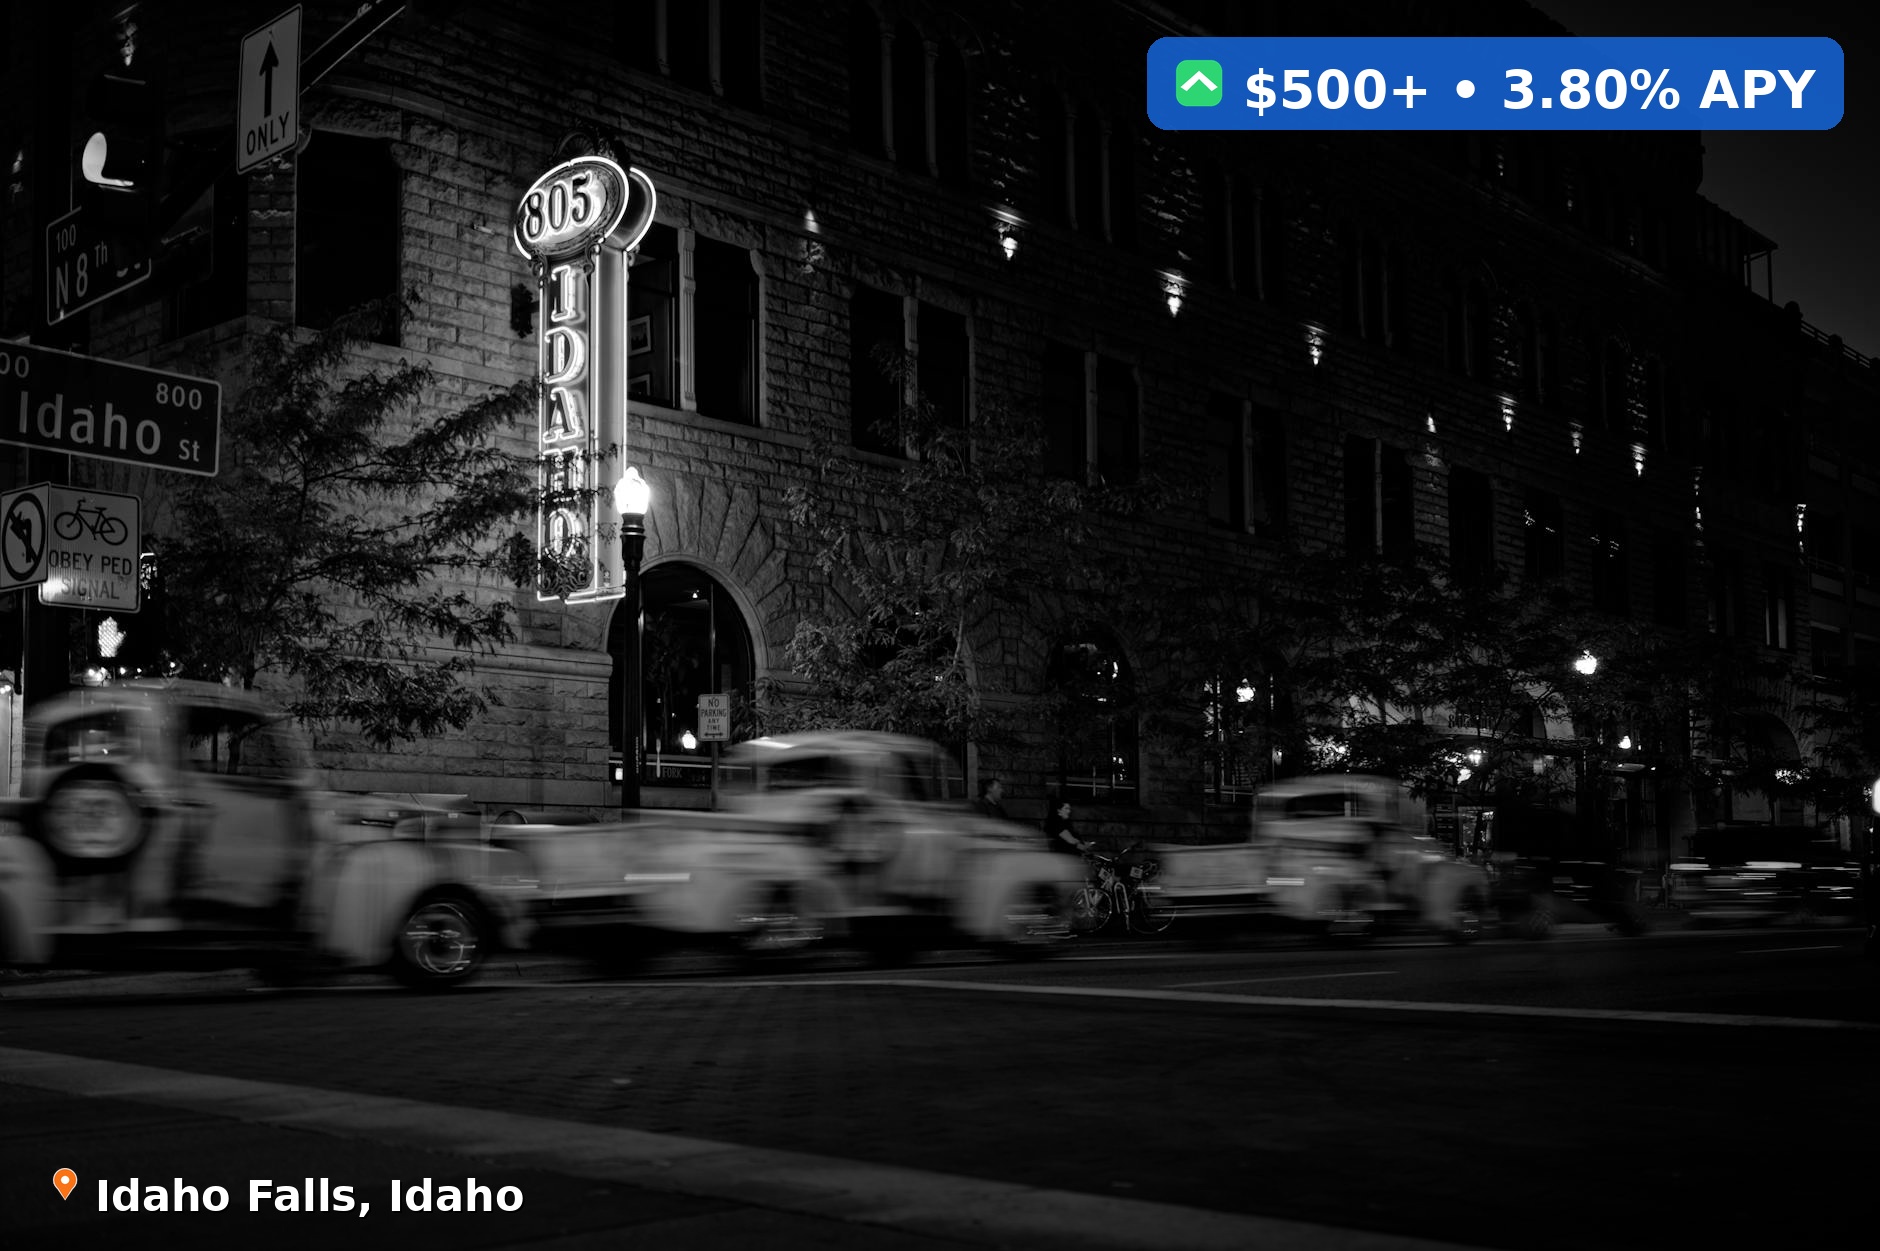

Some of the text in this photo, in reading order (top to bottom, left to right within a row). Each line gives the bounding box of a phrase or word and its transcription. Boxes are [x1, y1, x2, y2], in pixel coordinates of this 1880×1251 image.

[246, 111, 289, 155] ONLY
[524, 170, 595, 243] 805
[55, 223, 77, 254] 100
[55, 259, 69, 310] N
[155, 382, 203, 411] 800
[19, 390, 201, 463] Idaho St
[543, 264, 586, 560] IDAHO
[49, 550, 132, 576] OBEY PED
[61, 577, 120, 600] SIGNAL
[700, 708, 727, 718] PARKING
[708, 698, 720, 708] NO
[663, 767, 683, 779] FORK
